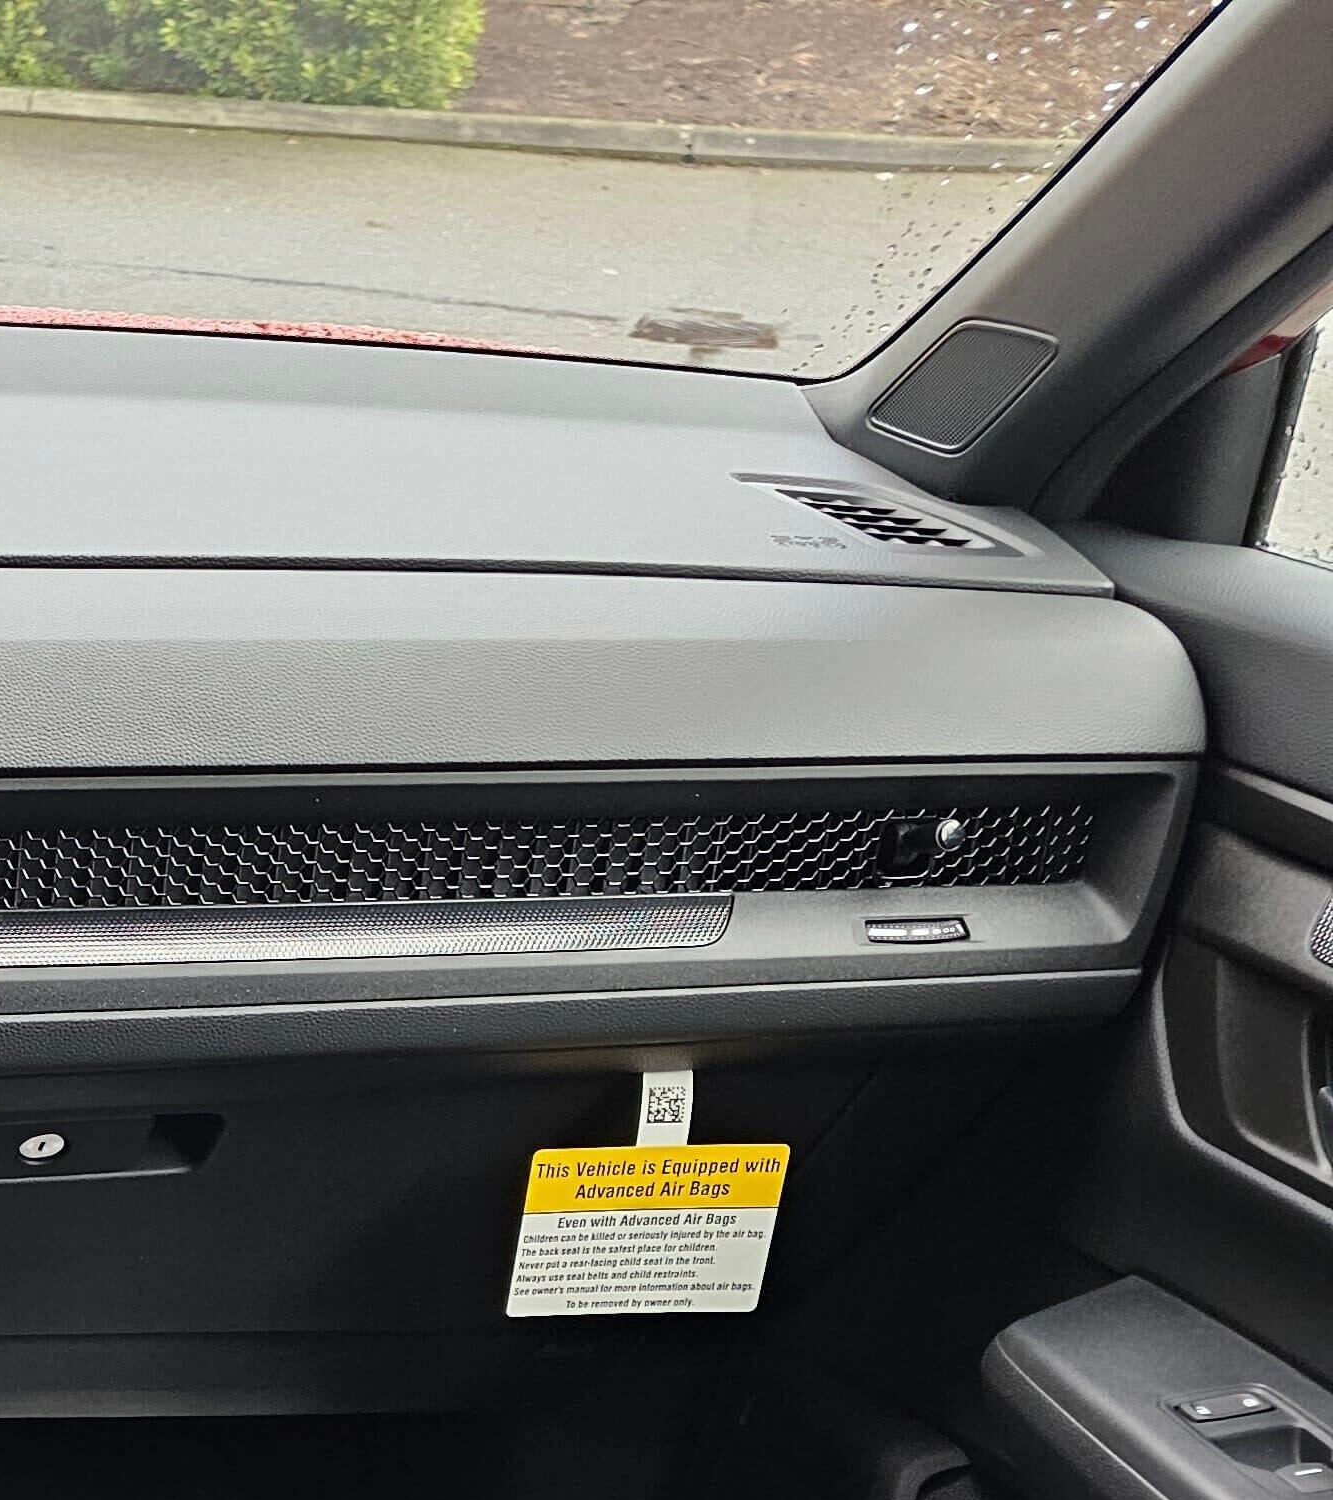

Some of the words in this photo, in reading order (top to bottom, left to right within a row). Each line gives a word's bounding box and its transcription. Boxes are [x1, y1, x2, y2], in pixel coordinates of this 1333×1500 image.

[537, 1163, 570, 1178] This
[577, 1161, 635, 1177] Vehicle
[643, 1160, 656, 1175] is
[662, 1158, 739, 1177] Equipped
[746, 1158, 780, 1173] with
[575, 1182, 655, 1199] Advanced
[660, 1181, 685, 1197] Air
[690, 1181, 730, 1199] Bags
[558, 1217, 586, 1229] Even
[591, 1216, 616, 1227] with
[620, 1214, 680, 1227] Advanced
[683, 1213, 702, 1225] Air
[706, 1213, 737, 1226] Bags
[523, 1235, 558, 1244] Children
[579, 1233, 589, 1241] be
[591, 1232, 615, 1241] killed
[629, 1231, 668, 1240] seriously
[670, 1230, 701, 1240] injured
[704, 1230, 713, 1239] by
[716, 1230, 729, 1238] the
[733, 1230, 745, 1238] air
[747, 1230, 766, 1239] bag.
[522, 1249, 536, 1257] The
[539, 1247, 558, 1256] back
[561, 1247, 579, 1255] seat
[582, 1246, 590, 1254] is
[593, 1246, 606, 1254] the
[609, 1245, 635, 1253] safest
[637, 1244, 661, 1254] place
[664, 1244, 676, 1252] for
[679, 1243, 717, 1252] children.
[519, 1262, 544, 1270] Never
[546, 1260, 560, 1270] put
[570, 1259, 617, 1268] rear-facing
[620, 1258, 641, 1266] child
[644, 1257, 662, 1266] seat
[676, 1257, 690, 1265] the
[516, 1275, 546, 1283] Always
[567, 1272, 585, 1281] seat
[588, 1272, 608, 1280] belts
[611, 1271, 627, 1279] and
[630, 1270, 651, 1279] child
[653, 1270, 699, 1278] restraints.
[514, 1288, 529, 1296] See
[533, 1286, 564, 1295] owner's
[567, 1285, 598, 1293] manual
[600, 1284, 612, 1292] for
[639, 1283, 688, 1291] information
[690, 1282, 715, 1291] about
[717, 1282, 729, 1290] air
[731, 1282, 755, 1291] bags.
[579, 1300, 588, 1308] be
[591, 1299, 629, 1308] removed
[632, 1299, 641, 1308] by
[644, 1299, 671, 1307] owner
[674, 1298, 695, 1308] only.
